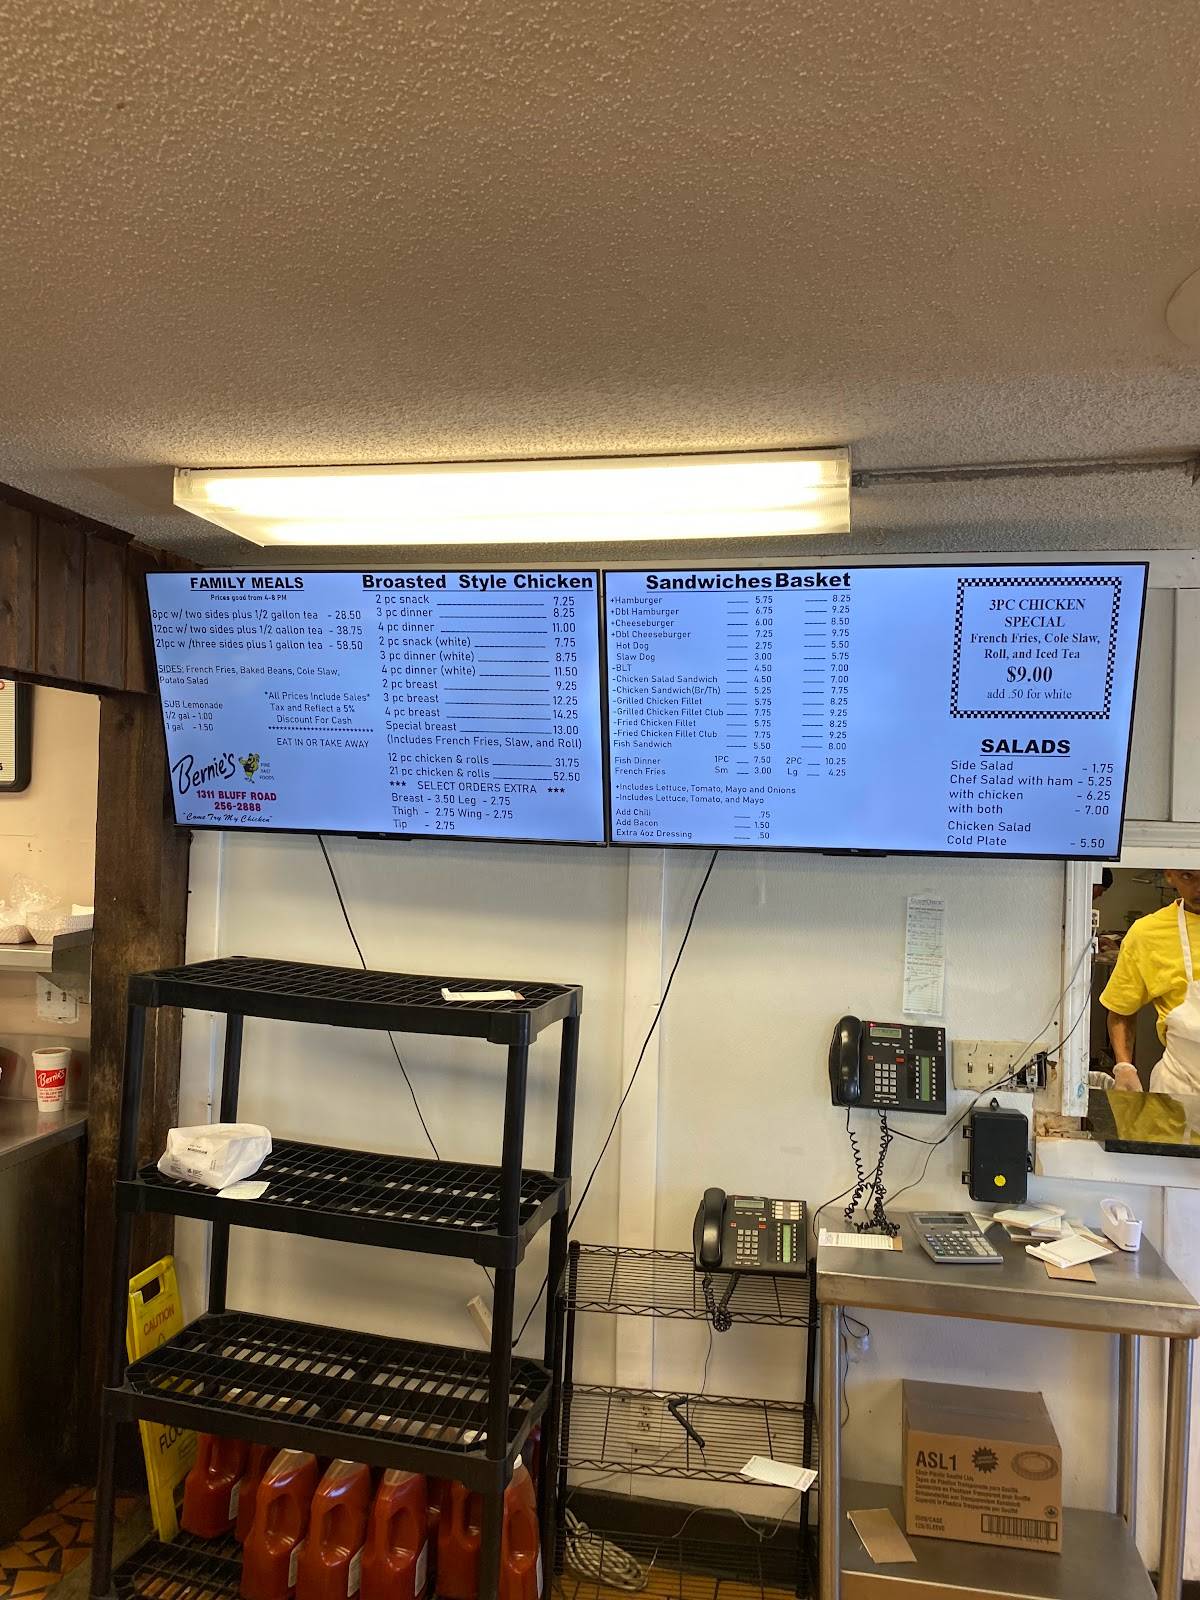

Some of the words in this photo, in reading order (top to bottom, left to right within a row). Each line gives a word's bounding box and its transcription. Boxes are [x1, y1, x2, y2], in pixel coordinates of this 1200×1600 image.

[191, 577, 246, 588] FAMILY
[252, 577, 303, 588] MEALS
[362, 575, 446, 588] Broasted
[459, 575, 507, 592] Style
[514, 574, 592, 588] Chicken
[647, 574, 772, 589] Sandwiches
[776, 572, 850, 587] Basket
[376, 594, 381, 603] 2
[385, 597, 396, 605] pc
[400, 594, 429, 603] snack
[554, 596, 574, 606] 7.25
[989, 599, 1015, 610] 3PC
[1019, 599, 1085, 610] CHICKEN
[152, 610, 168, 620] 8pc
[205, 610, 229, 618] sides
[233, 610, 252, 620] plus
[271, 610, 300, 621] gallon
[304, 609, 318, 619] tea
[336, 611, 361, 619] 28.50
[377, 607, 382, 616] 3
[386, 610, 397, 619] pc
[401, 607, 432, 616] dinner
[554, 608, 574, 617] 8.25
[632, 608, 679, 617] Hamburger
[832, 605, 849, 613] 9.25
[1005, 616, 1064, 627] SPECIAL
[971, 634, 1007, 643] French
[1012, 633, 1040, 644] Fries,
[1045, 633, 1068, 643] Cole
[1072, 633, 1100, 644] Slaw,
[380, 651, 385, 659] 3
[390, 653, 400, 662] pc
[404, 651, 436, 660] dinner
[440, 651, 474, 662] (white)
[556, 653, 576, 662] 8.75
[640, 653, 655, 662] Dog
[985, 649, 1009, 660] Roll,
[1013, 649, 1031, 658] and
[1036, 649, 1057, 658] Iced
[1062, 649, 1079, 658] Tea
[678, 675, 717, 683] Sandwich
[1007, 666, 1052, 682] $9.00
[282, 692, 308, 700] Prices
[311, 692, 340, 700] Include
[988, 689, 1005, 698] add
[1027, 689, 1039, 699] for
[1045, 689, 1071, 699] white
[270, 703, 284, 711] Tax
[305, 704, 333, 712] Reflect
[386, 721, 421, 731] Special
[425, 722, 456, 731] breast
[553, 726, 578, 734] 13.00
[320, 739, 342, 747] TAKE
[387, 734, 432, 744] (Includes
[436, 736, 469, 745] French
[474, 737, 501, 747] Fries,
[505, 737, 532, 748] Slaw,
[536, 739, 554, 747] and
[558, 739, 581, 749] Roll)
[633, 740, 672, 748] Sandwich
[981, 739, 1070, 754] SALADS
[952, 760, 975, 769] Side
[981, 761, 1013, 770] Salad
[1093, 764, 1113, 773] 1.75
[390, 766, 398, 774] 21
[416, 767, 453, 776] chicken
[457, 768, 463, 777] &
[467, 769, 489, 777] rolls
[554, 772, 580, 781] 52.50
[951, 775, 977, 784] Chef
[981, 775, 1013, 784] Salad
[1018, 776, 1042, 785] with
[1048, 776, 1072, 785] ham
[1089, 777, 1111, 786] 5.25
[418, 781, 455, 790] SELECT
[459, 783, 500, 792] ORDERS
[504, 784, 536, 793] EXTRA
[196, 790, 214, 798] 1311
[218, 791, 246, 799] BLUFF
[251, 792, 276, 800] ROAD
[950, 789, 973, 798] with
[979, 790, 1023, 799] chicken
[1087, 791, 1110, 800] 6.25
[215, 802, 261, 811] 256-2888
[949, 804, 972, 813] with
[978, 804, 1002, 814] both
[1086, 805, 1109, 815] 7.00
[392, 806, 418, 817] Thigh
[436, 808, 454, 816] 2.75
[458, 809, 481, 820] Wing
[494, 810, 512, 818] 2.75
[948, 821, 993, 831] Chicken
[998, 822, 1031, 831] Salad
[657, 830, 692, 839] Dressing
[947, 835, 972, 844] Cold
[977, 836, 1006, 845] Plate
[1081, 839, 1104, 848] 5.50
[143, 1304, 175, 1336] CAUTION
[916, 1450, 957, 1471] ASL1
